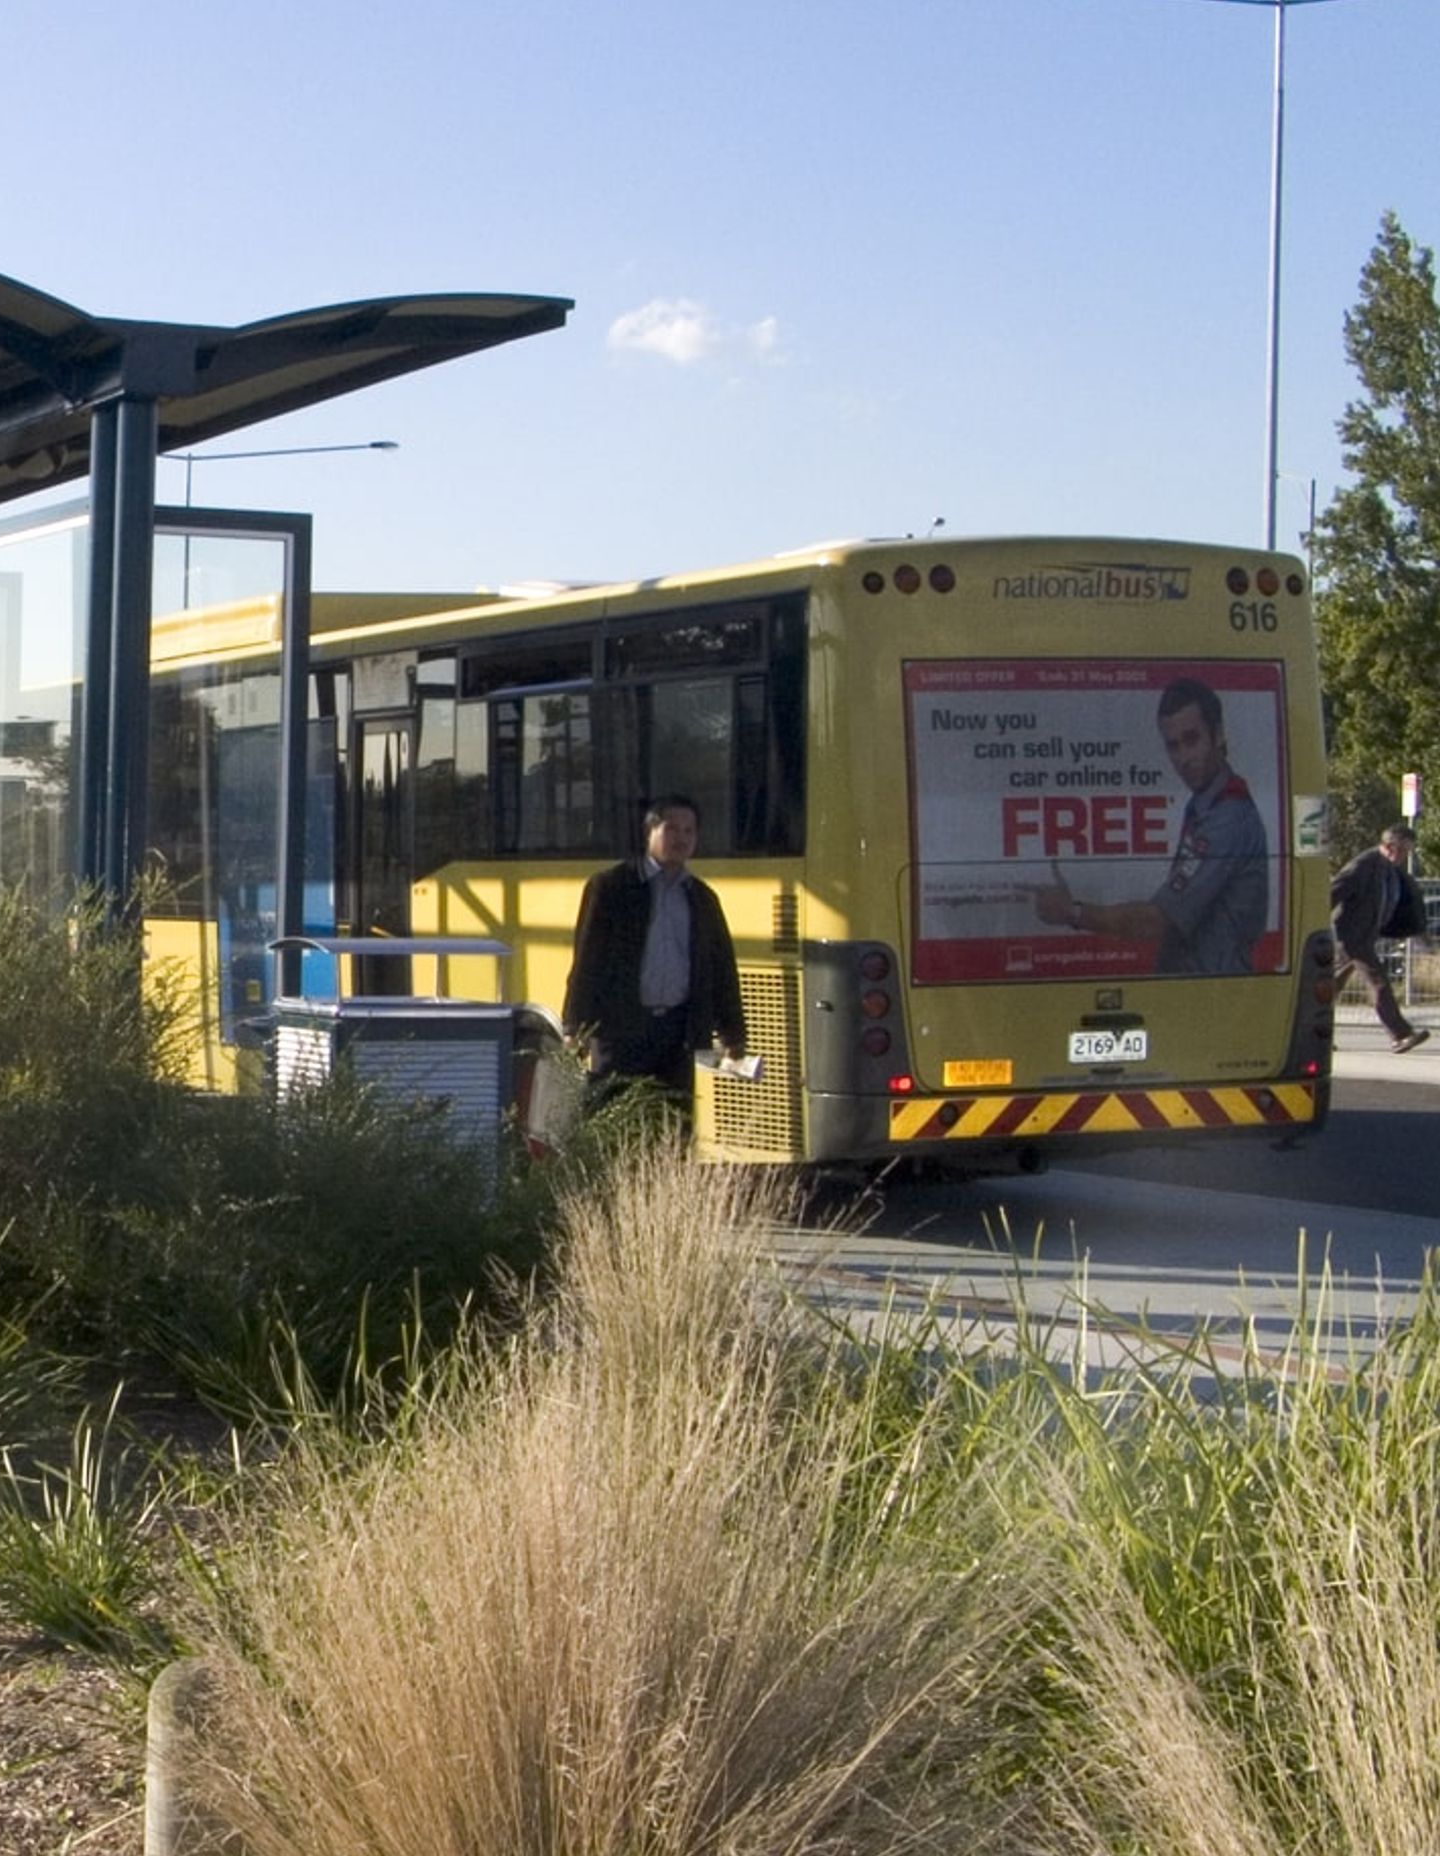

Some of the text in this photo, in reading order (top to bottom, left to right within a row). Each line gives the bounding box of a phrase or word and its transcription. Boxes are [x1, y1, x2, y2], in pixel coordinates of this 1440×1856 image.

[992, 571, 1156, 599] nationalbus
[1228, 602, 1278, 632] 616
[931, 709, 1037, 735] Now you
[973, 737, 1121, 762] can sell your
[1009, 764, 1163, 787] car online for
[1074, 1038, 1114, 1055] 2169
